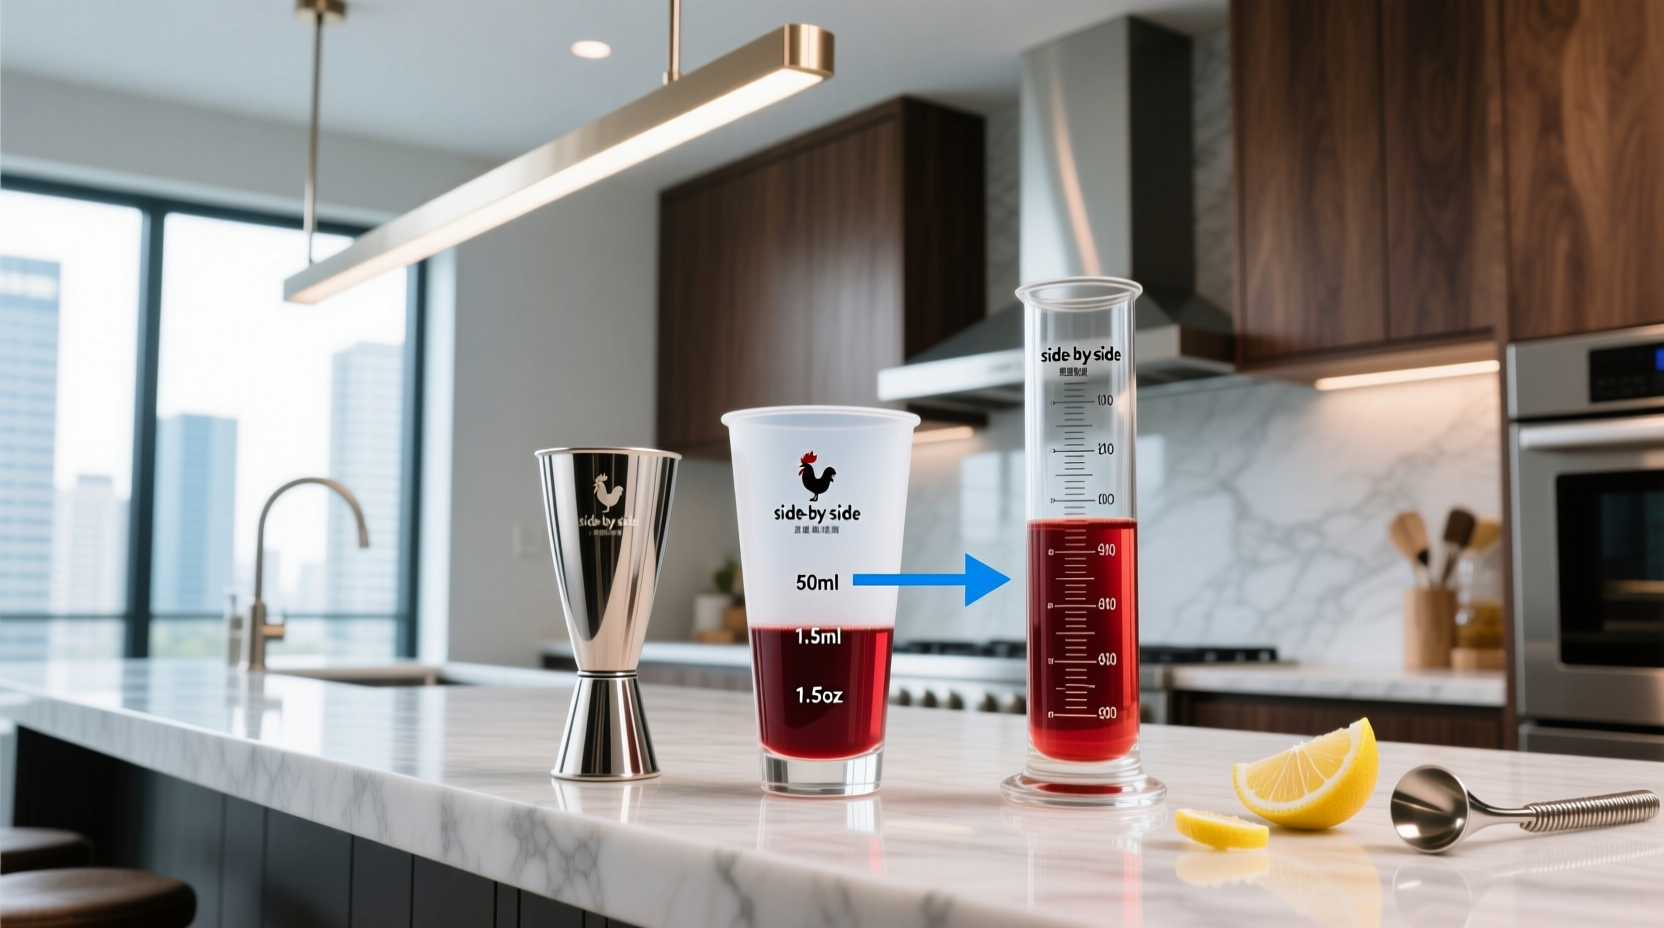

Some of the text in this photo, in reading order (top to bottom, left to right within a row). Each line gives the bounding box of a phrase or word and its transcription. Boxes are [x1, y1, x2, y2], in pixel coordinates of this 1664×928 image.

[1041, 345, 1121, 365] side by side
[808, 504, 826, 524] by
[829, 504, 861, 521] side
[796, 573, 839, 591] 50ml
[795, 626, 841, 645] 1.5ml
[795, 686, 844, 703] 1.5oz
